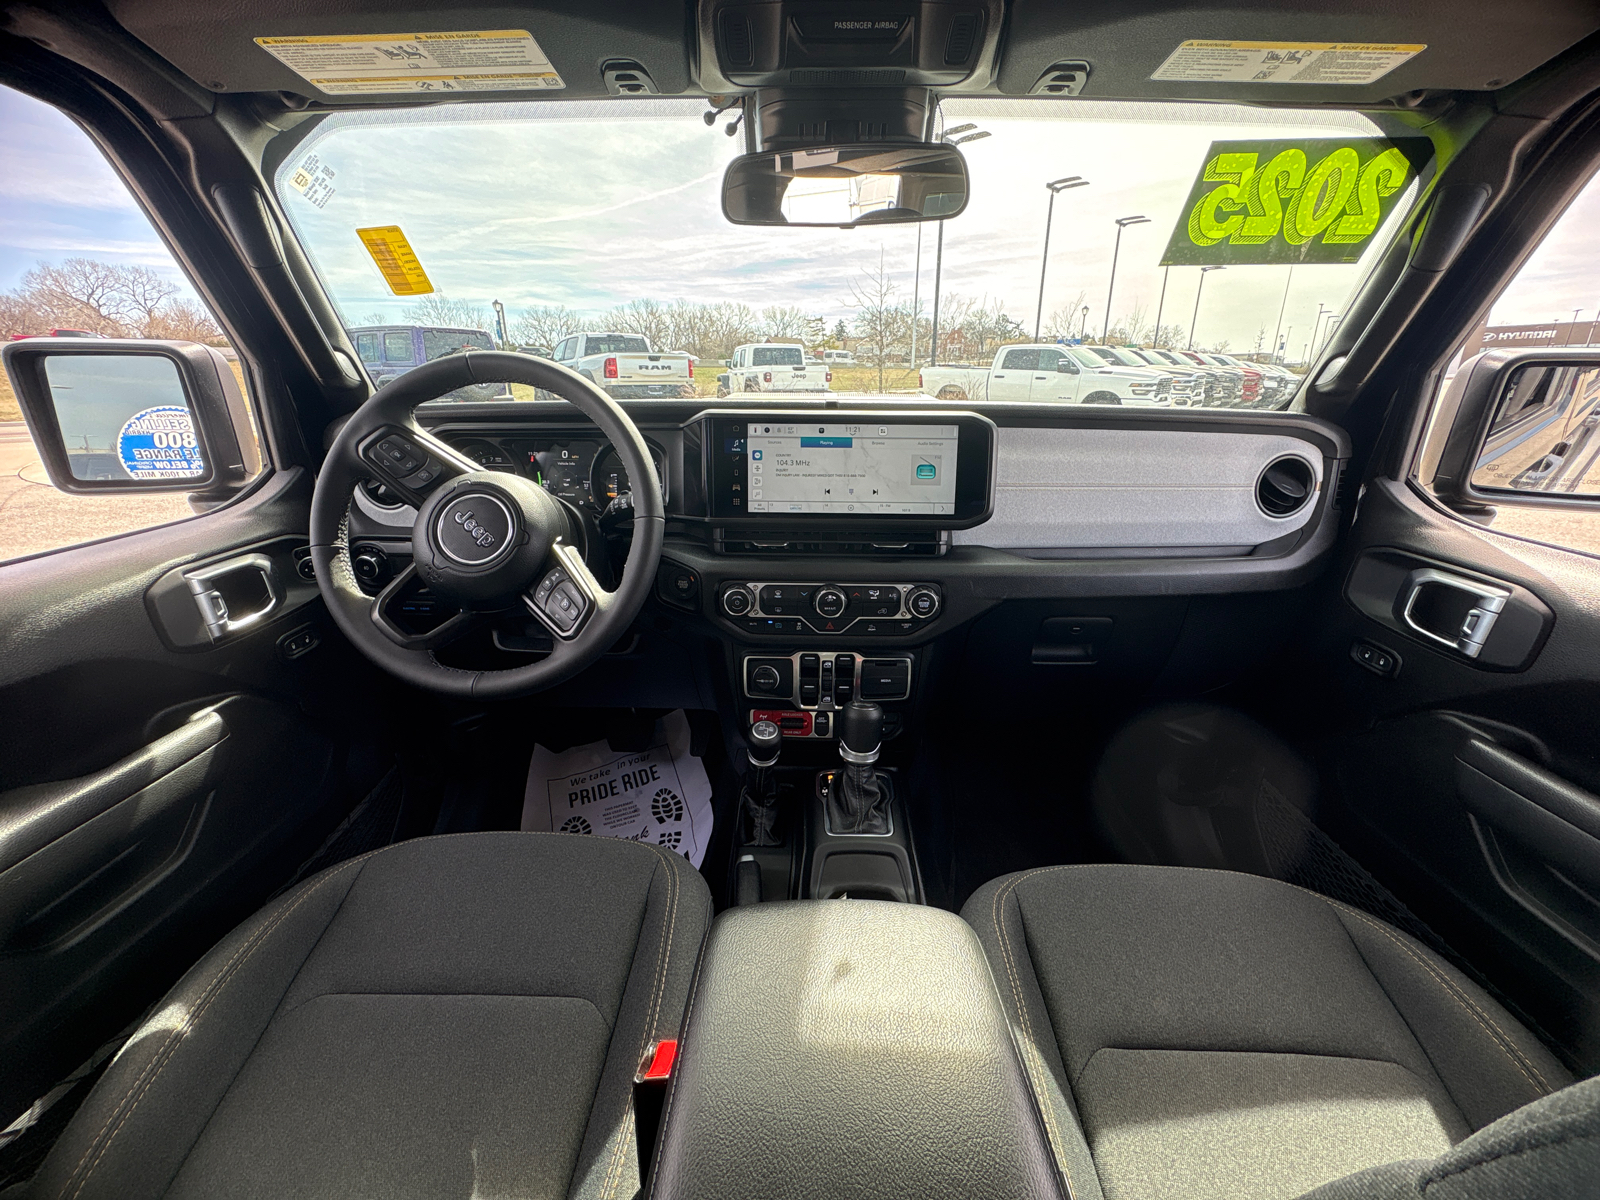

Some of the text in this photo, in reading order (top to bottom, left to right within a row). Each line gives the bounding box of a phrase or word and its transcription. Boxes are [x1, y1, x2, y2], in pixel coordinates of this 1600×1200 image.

[834, 21, 899, 30] PASSENGER AIRBAG
[1498, 329, 1557, 341] HYUNDAI
[791, 371, 807, 380] Jeep
[561, 450, 569, 459] 0
[776, 459, 795, 467] 104.3
[454, 510, 495, 548] Jeep
[570, 754, 650, 787] We take in your
[568, 764, 661, 808] PRIDE RIDE
